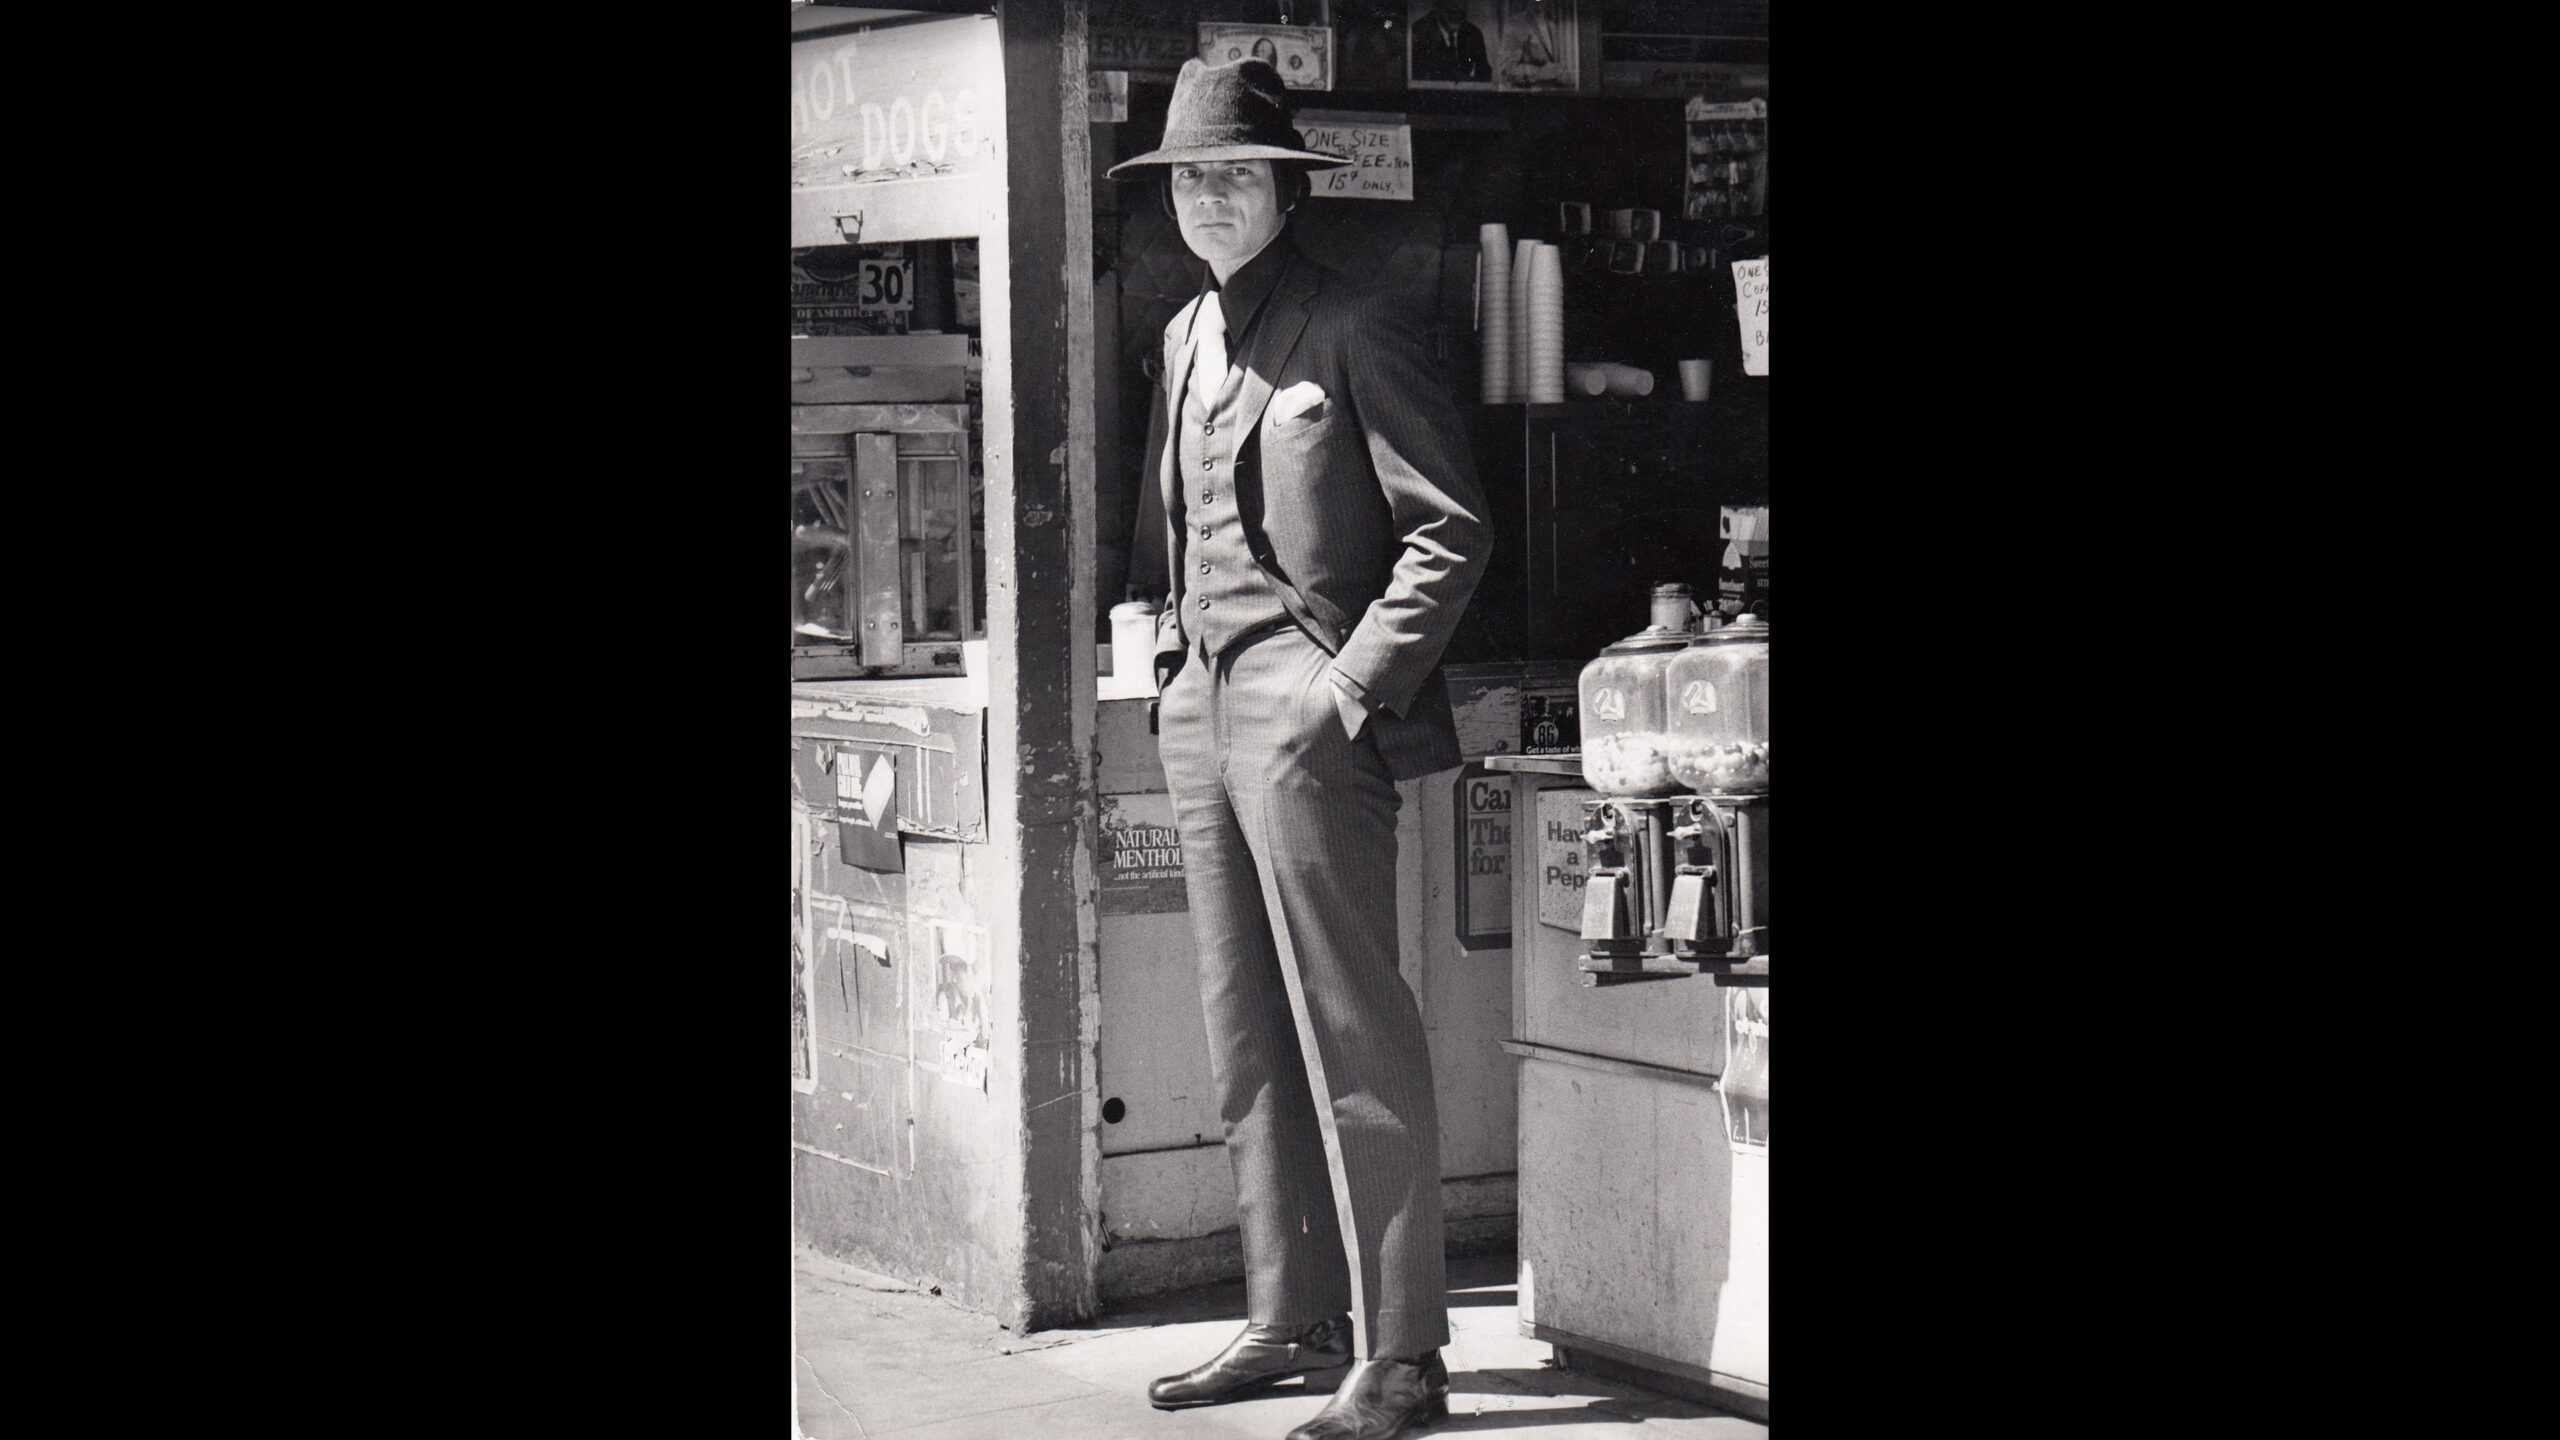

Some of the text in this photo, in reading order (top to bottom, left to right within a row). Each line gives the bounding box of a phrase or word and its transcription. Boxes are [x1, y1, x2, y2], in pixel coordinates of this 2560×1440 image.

[861, 89, 980, 170] DOGS
[1304, 128, 1390, 149] ONE SIZE
[1737, 265, 1762, 280] ONE
[796, 308, 814, 319] OF
[1538, 724, 1555, 745] 86
[1526, 745, 1539, 754] Get
[1545, 746, 1561, 754] taste
[1562, 745, 1570, 753] of
[1116, 828, 1180, 849] NATURAL
[1113, 847, 1184, 869] MENTHOL
[1470, 847, 1505, 876] for
[1566, 851, 1579, 865] a
[1130, 870, 1141, 880] the
